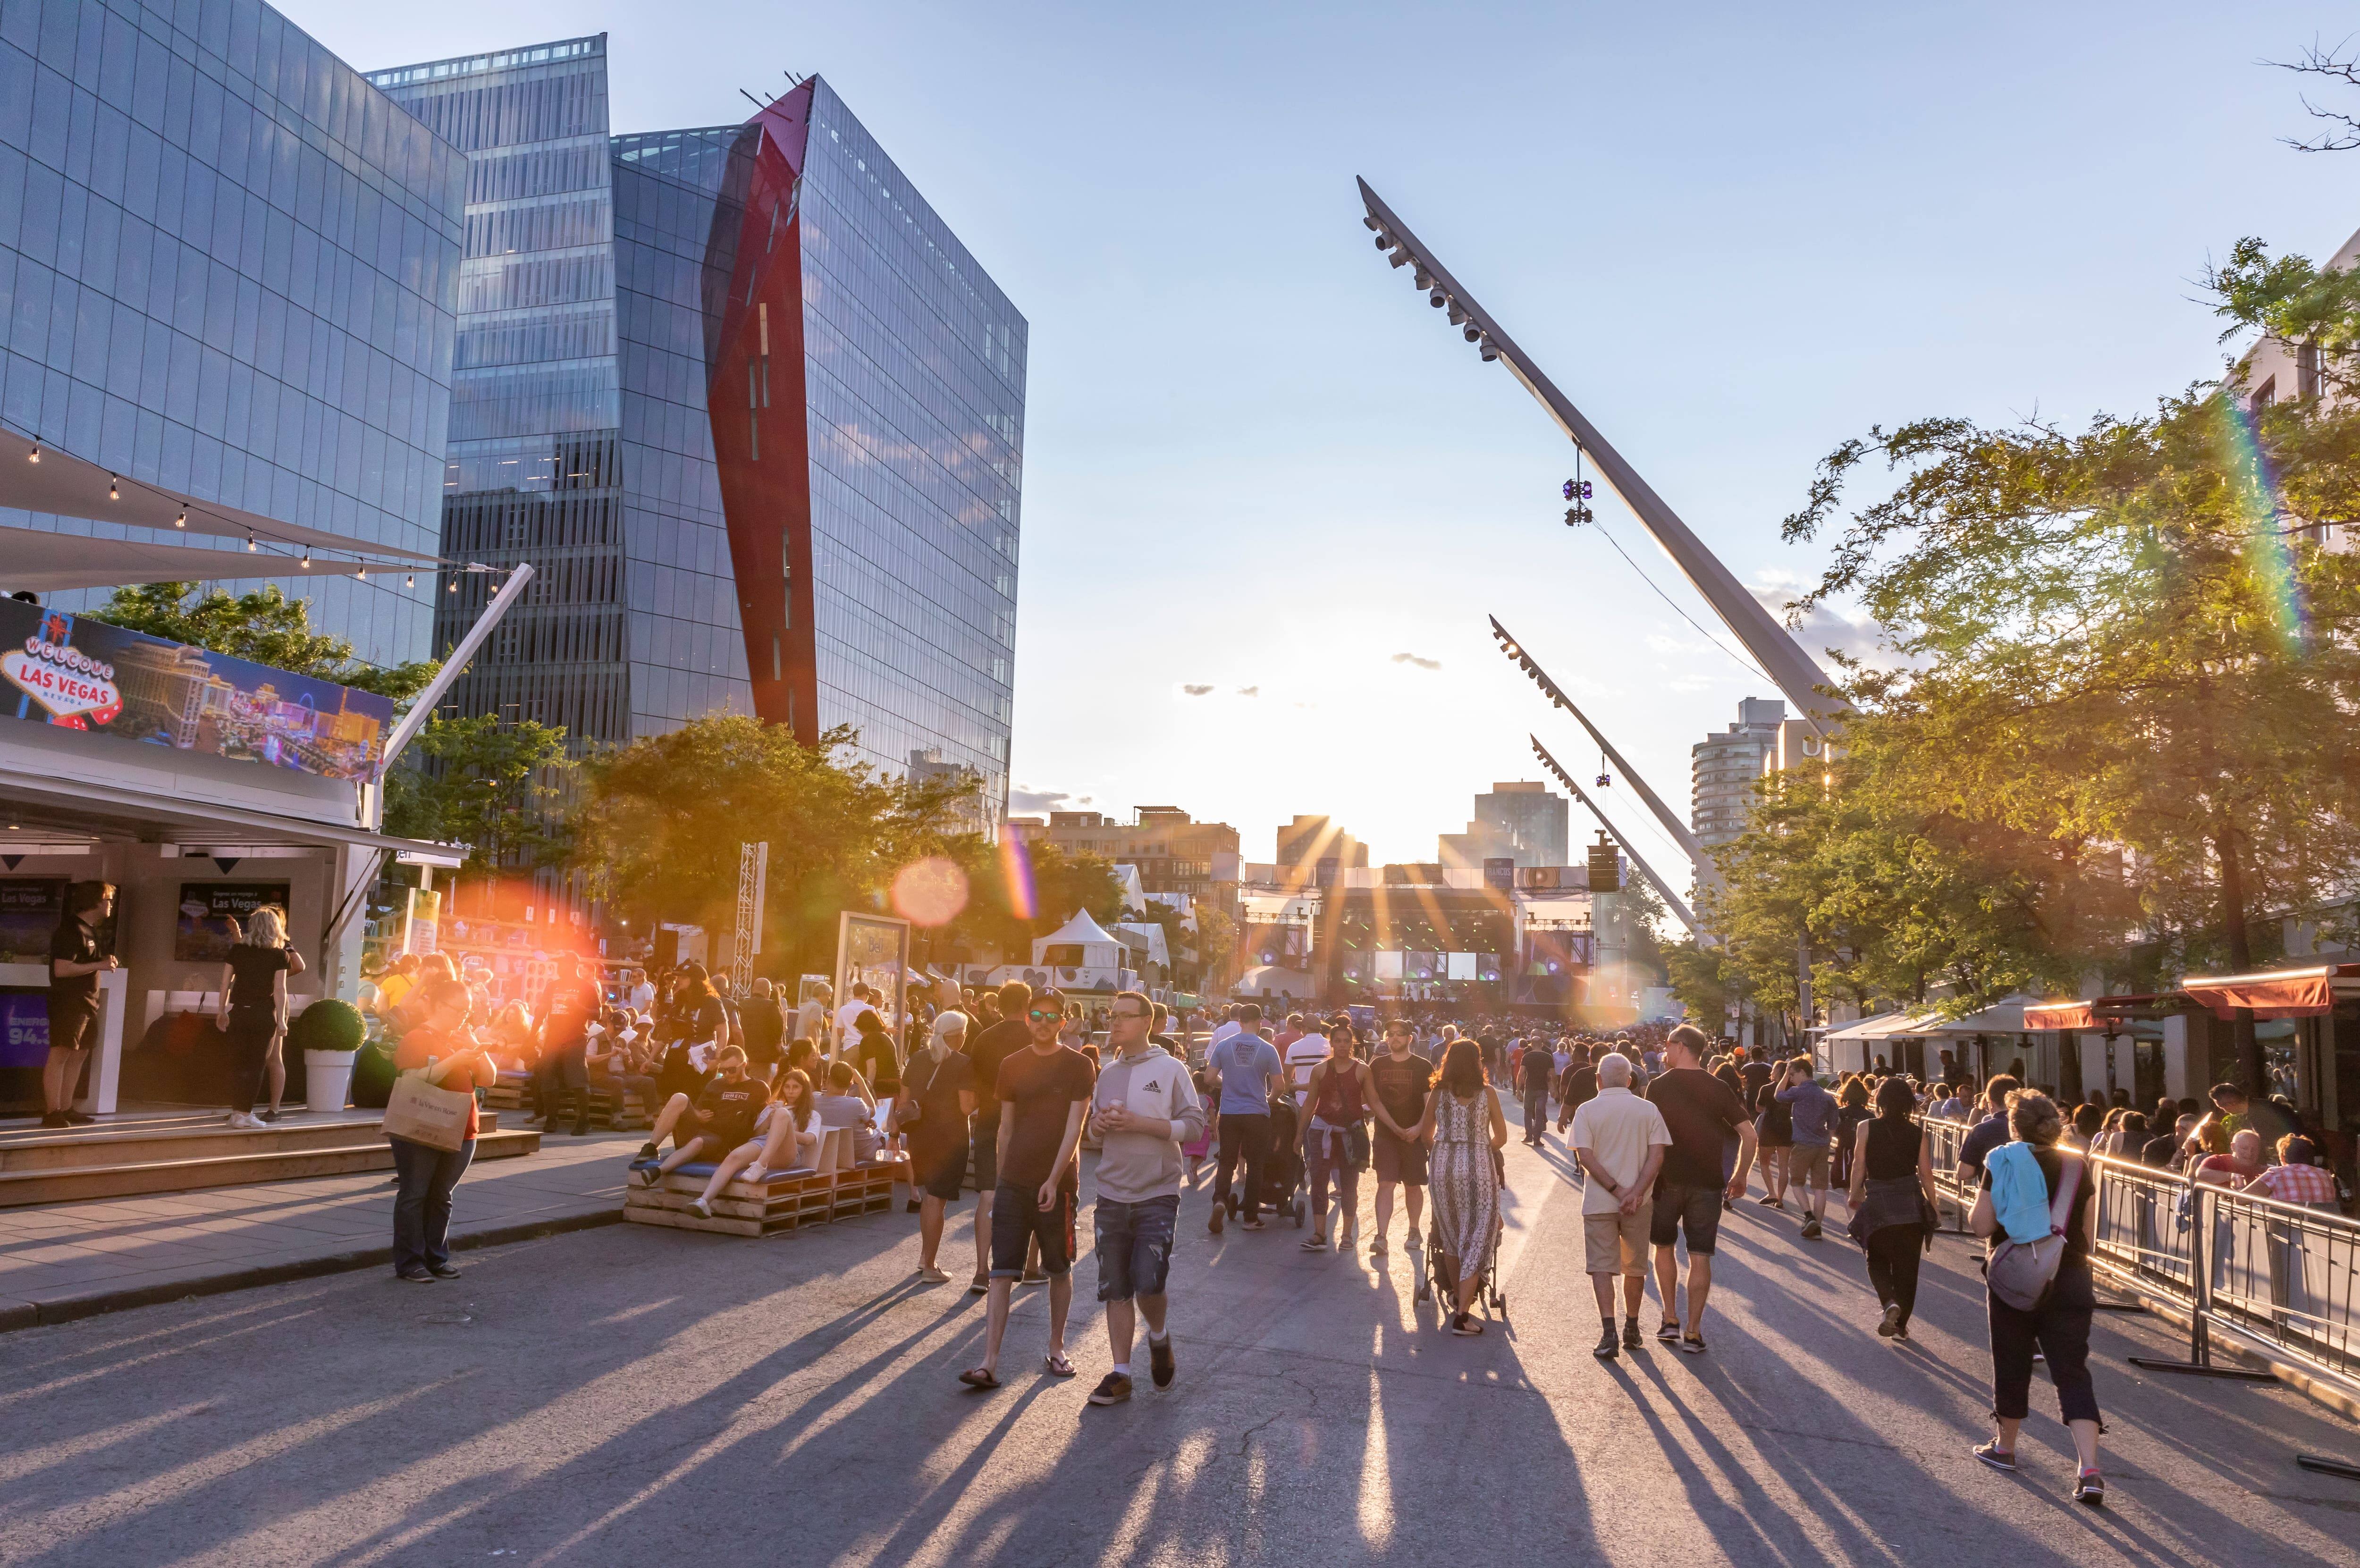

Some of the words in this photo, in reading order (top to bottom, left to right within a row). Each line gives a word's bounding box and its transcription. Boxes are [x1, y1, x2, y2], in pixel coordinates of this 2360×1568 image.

[29, 639, 112, 678] WELCOME
[19, 664, 54, 688] LAS
[59, 676, 109, 705] VEGAS
[1318, 867, 1341, 876] FRANCOS
[1486, 867, 1511, 877] FRANCOS
[2, 893, 16, 903] Las
[19, 893, 46, 906] Vegas
[212, 898, 229, 909] Las
[231, 898, 262, 911] Vegas
[868, 936, 884, 953] Bell
[442, 1107, 457, 1116] Rose
